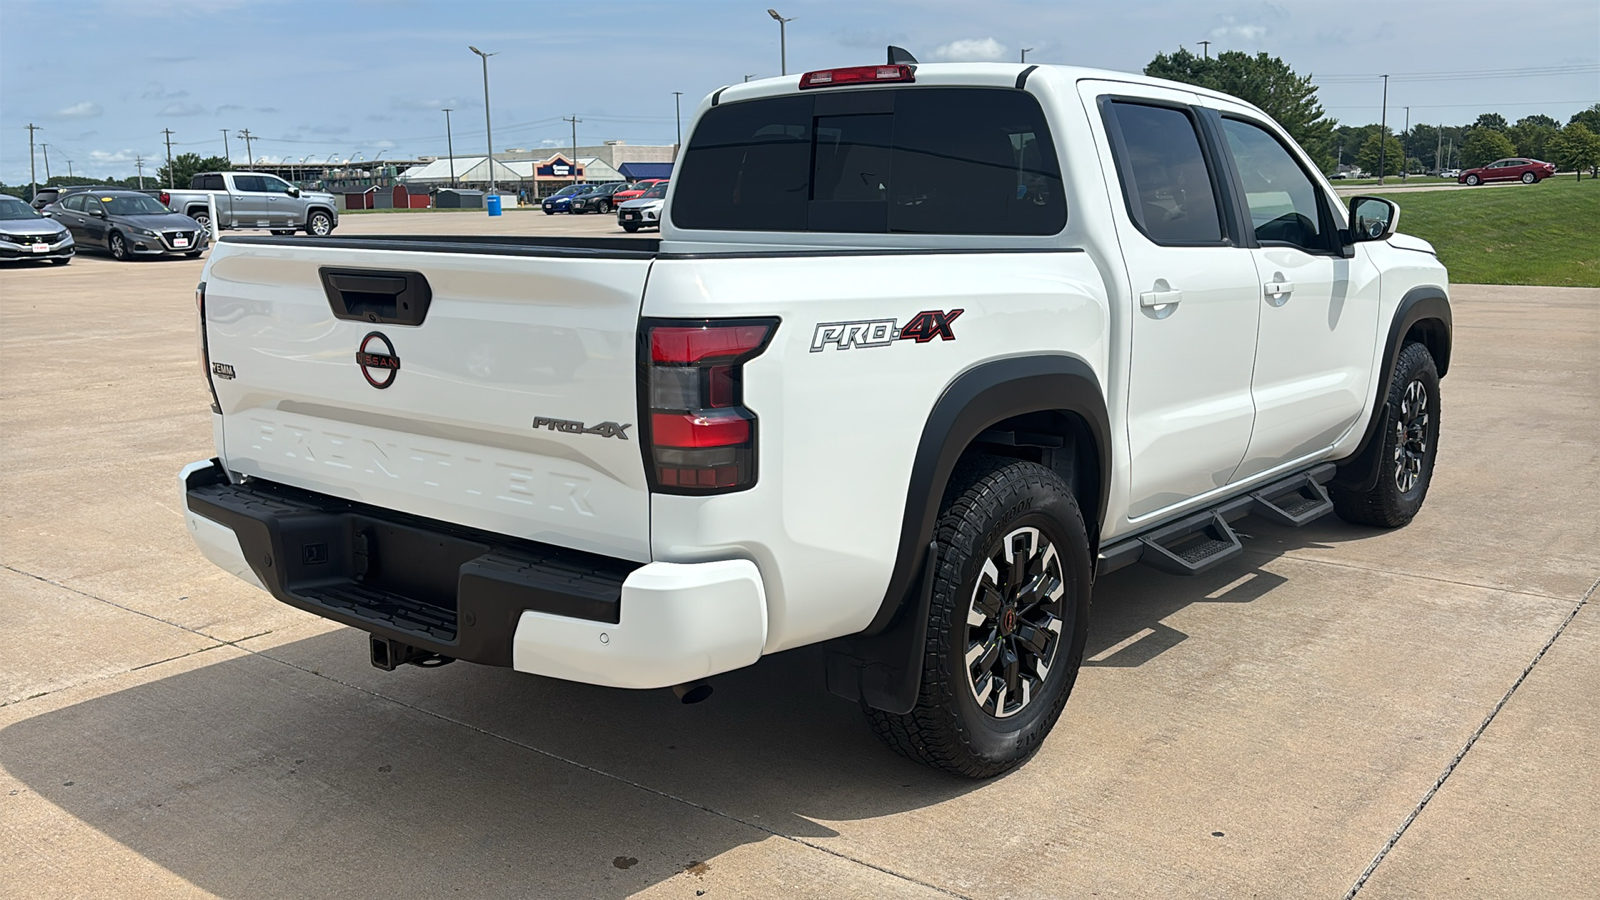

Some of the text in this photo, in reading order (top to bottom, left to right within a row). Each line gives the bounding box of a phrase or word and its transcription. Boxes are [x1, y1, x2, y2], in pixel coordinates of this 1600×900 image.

[809, 308, 965, 353] PRO-4X
[357, 353, 398, 368] NISSAN
[532, 416, 632, 441] PRO-4X
[250, 417, 596, 517] FRONTIER
